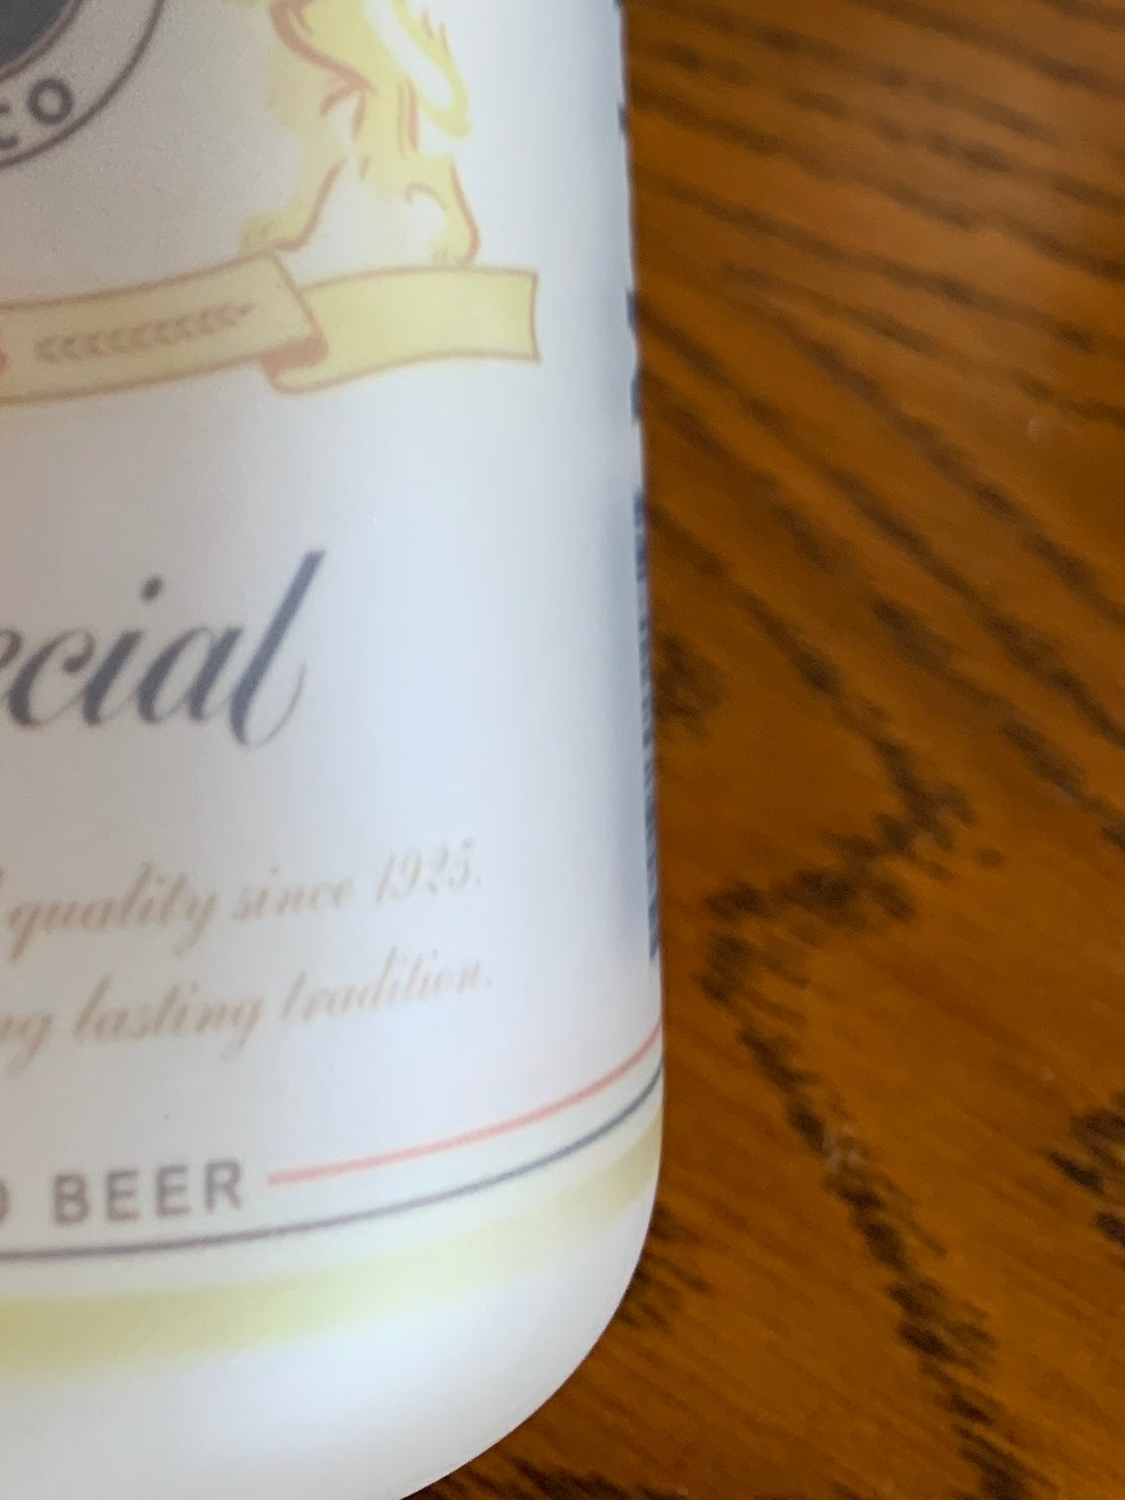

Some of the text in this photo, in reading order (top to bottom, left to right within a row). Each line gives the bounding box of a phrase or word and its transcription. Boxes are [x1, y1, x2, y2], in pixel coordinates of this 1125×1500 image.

[7, 859, 220, 962] quality
[230, 862, 355, 923] since
[375, 837, 482, 905] 1925.
[74, 975, 263, 1065] lasting
[280, 943, 493, 1024] tradition.
[51, 1156, 245, 1226] BEER
